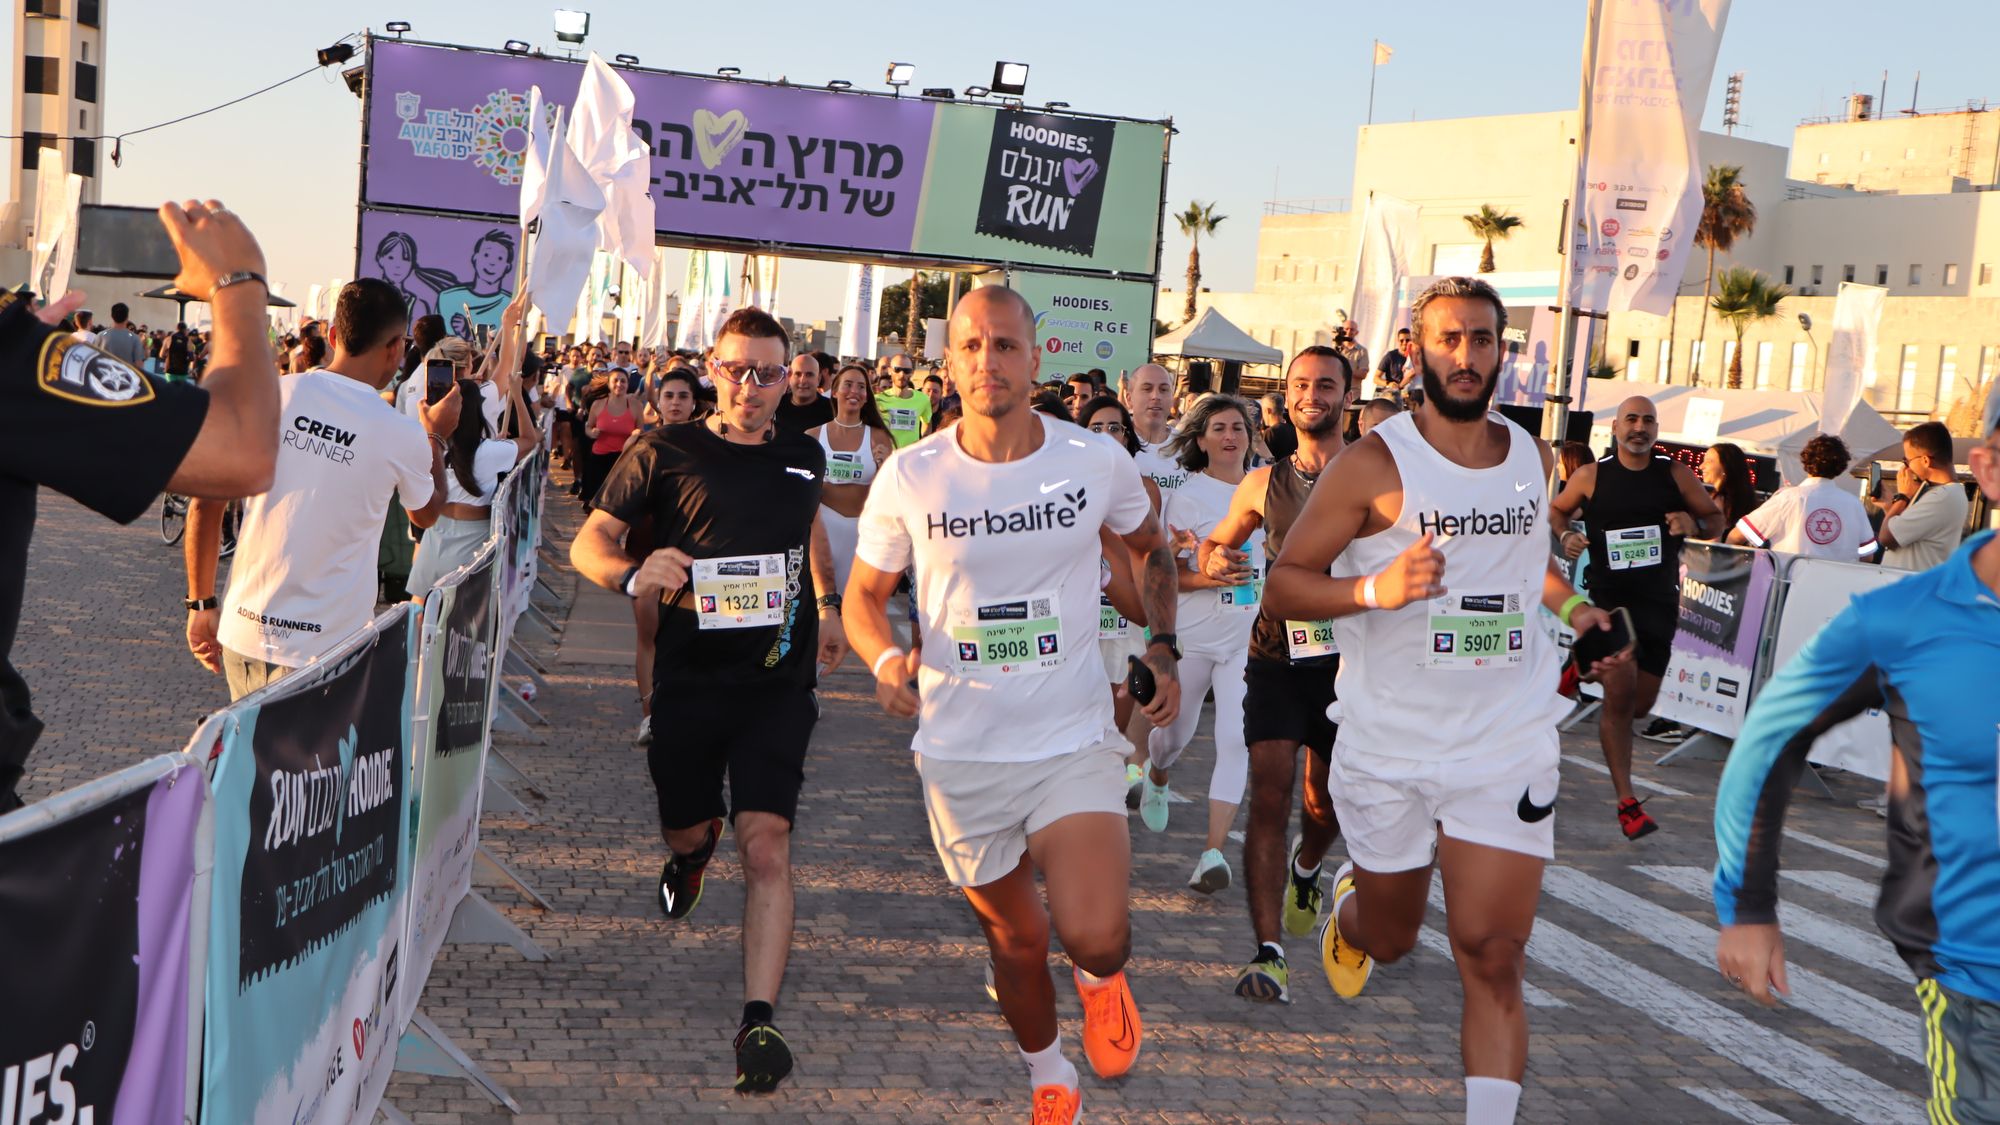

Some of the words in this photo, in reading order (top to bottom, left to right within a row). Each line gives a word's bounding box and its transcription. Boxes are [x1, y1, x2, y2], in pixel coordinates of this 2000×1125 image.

[426, 111, 450, 126] TEL
[402, 123, 434, 139] AVIV
[414, 140, 450, 158] YAFO
[787, 133, 904, 179] מרוץ
[1001, 147, 1061, 187] ינגלם
[840, 178, 895, 217] של
[1006, 184, 1076, 232] RUN
[1046, 337, 1083, 354] ynet
[294, 416, 357, 447] CREW
[283, 429, 355, 466] RUNNER
[832, 469, 850, 478] 5978
[927, 501, 1076, 540] Herbalife
[1419, 507, 1534, 537] Herbalife
[1624, 549, 1646, 559] 6249
[725, 594, 759, 611] 1322
[238, 606, 268, 625] ADIDAS
[269, 617, 322, 633] RUNNERS
[1469, 618, 1485, 628] הלוי
[1487, 619, 1498, 627] דור
[988, 640, 1029, 660] 5908
[1464, 634, 1501, 652] 5907
